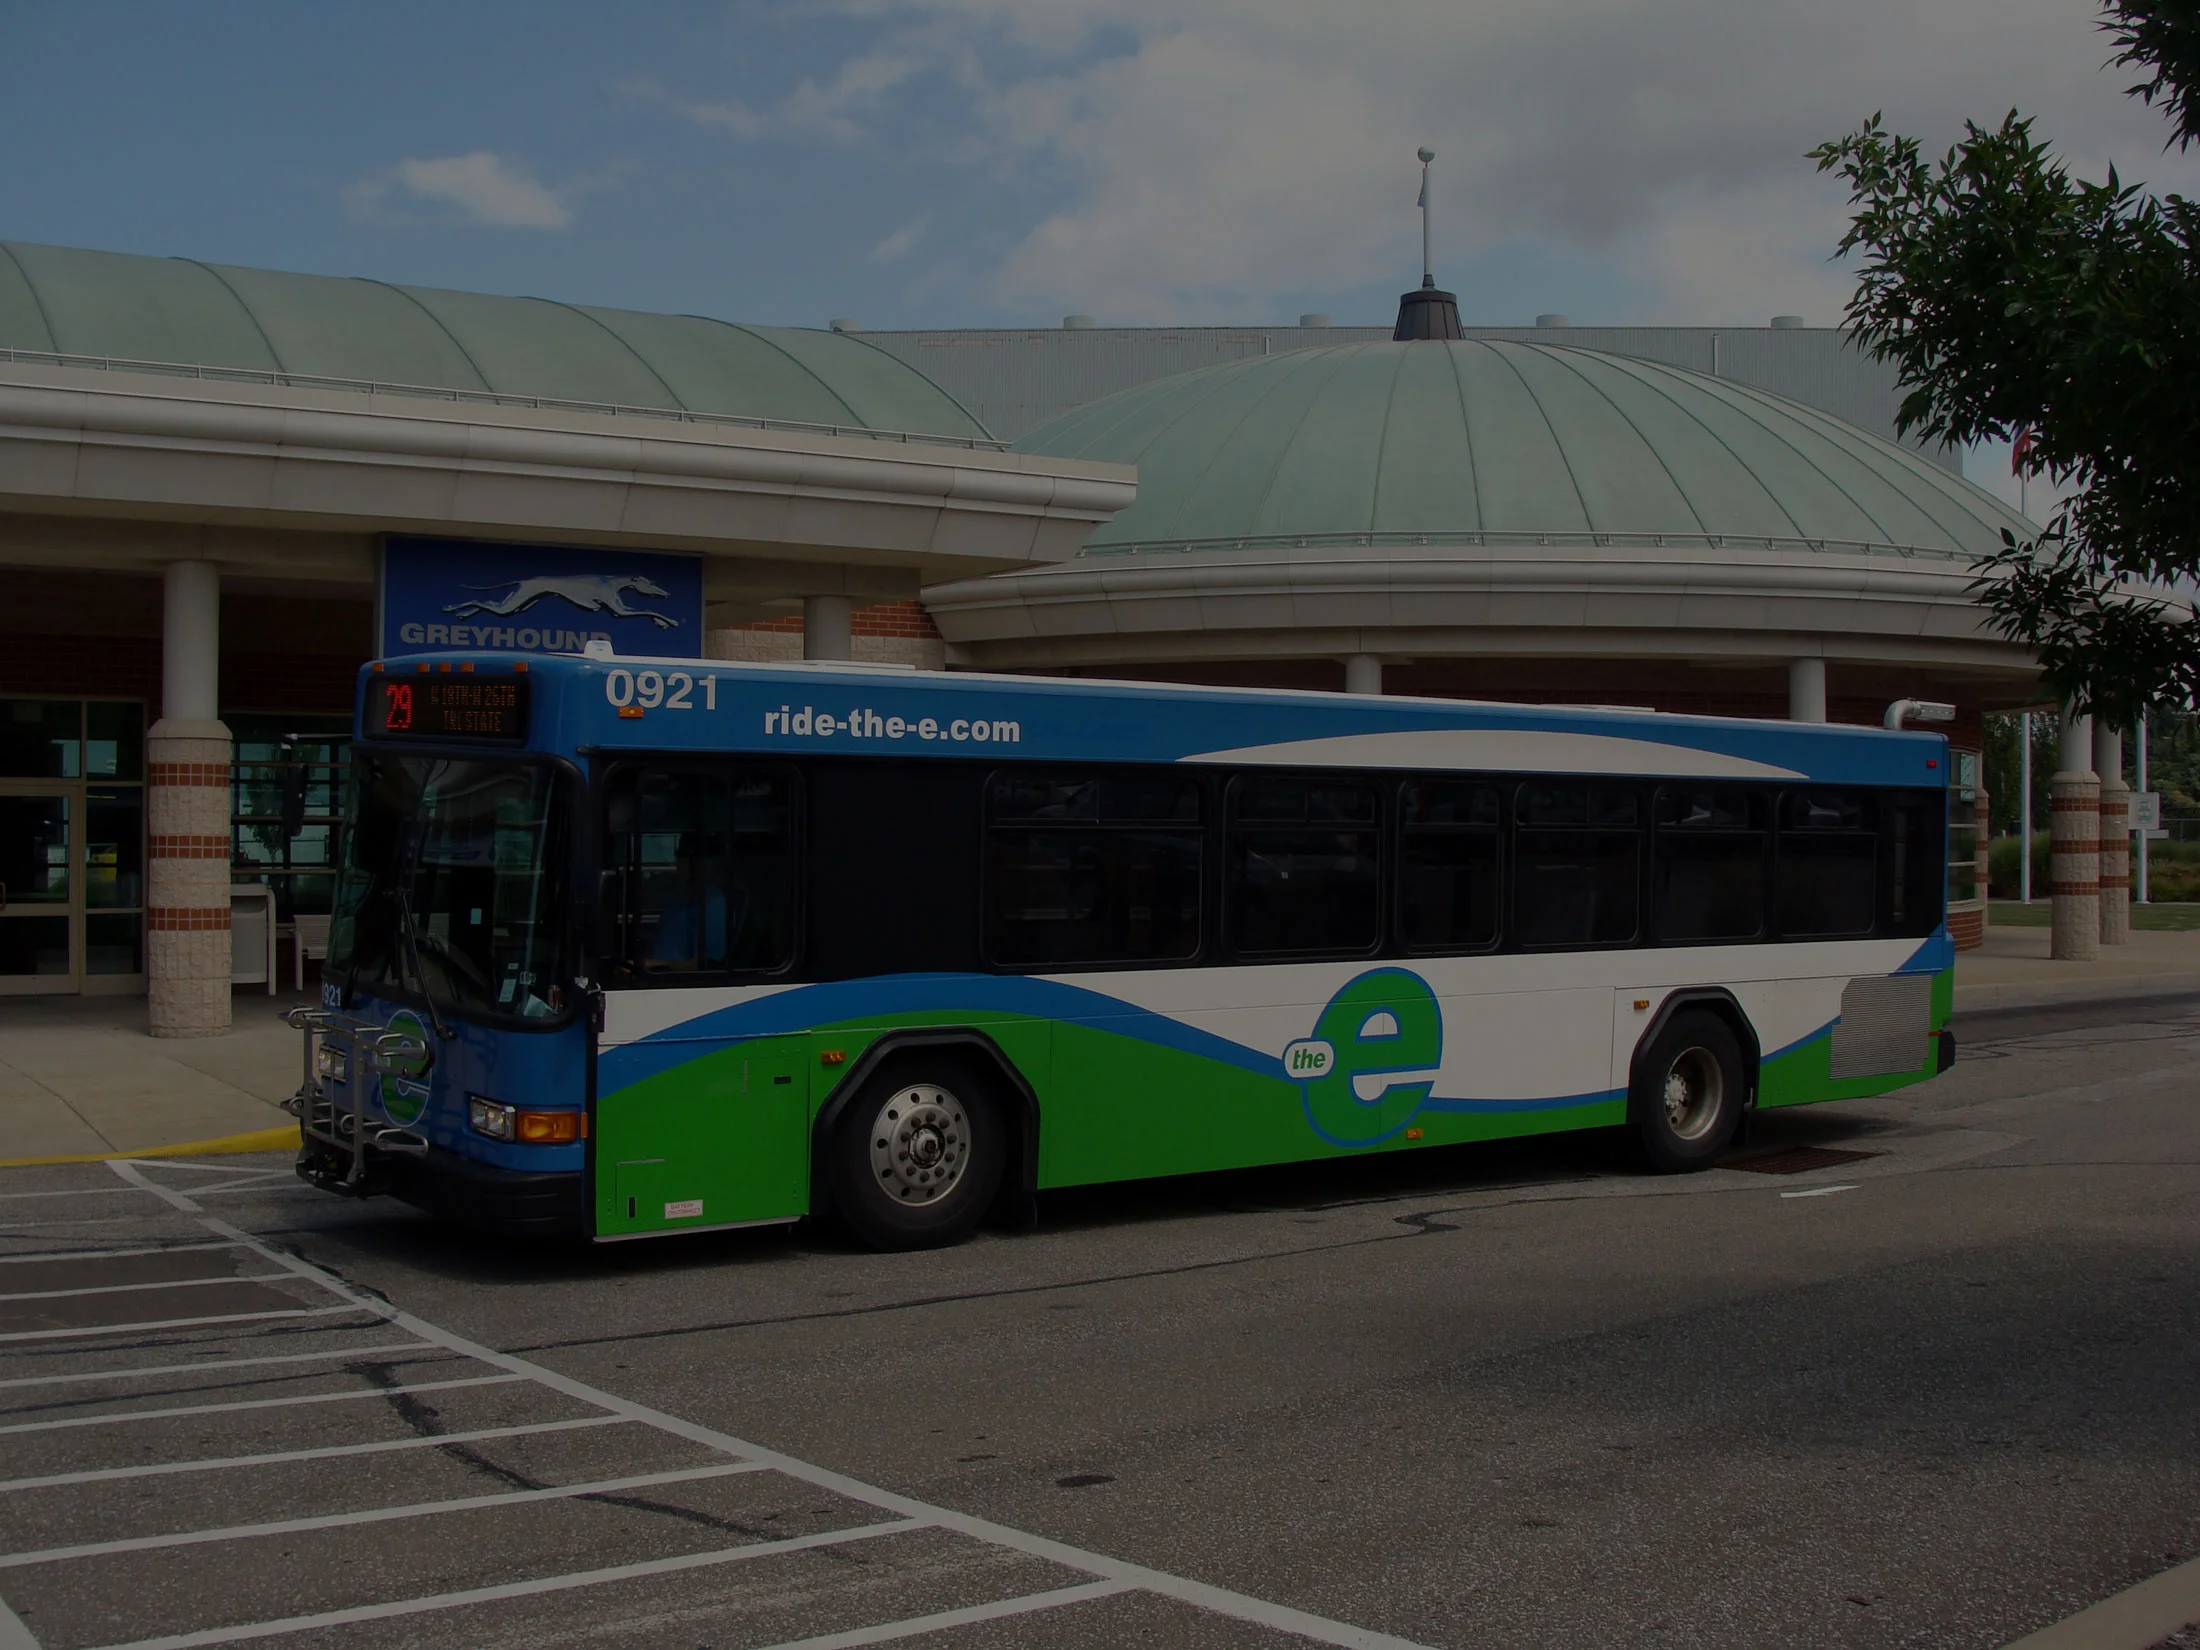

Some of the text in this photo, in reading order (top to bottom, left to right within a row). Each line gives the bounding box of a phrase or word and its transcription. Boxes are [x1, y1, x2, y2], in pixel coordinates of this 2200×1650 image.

[385, 684, 413, 729] 29
[605, 668, 717, 711] 0921
[464, 711, 503, 732] STATE
[764, 704, 1021, 743] ride-the-e.com
[323, 981, 342, 1007] 921
[1292, 966, 1444, 1149] the e
